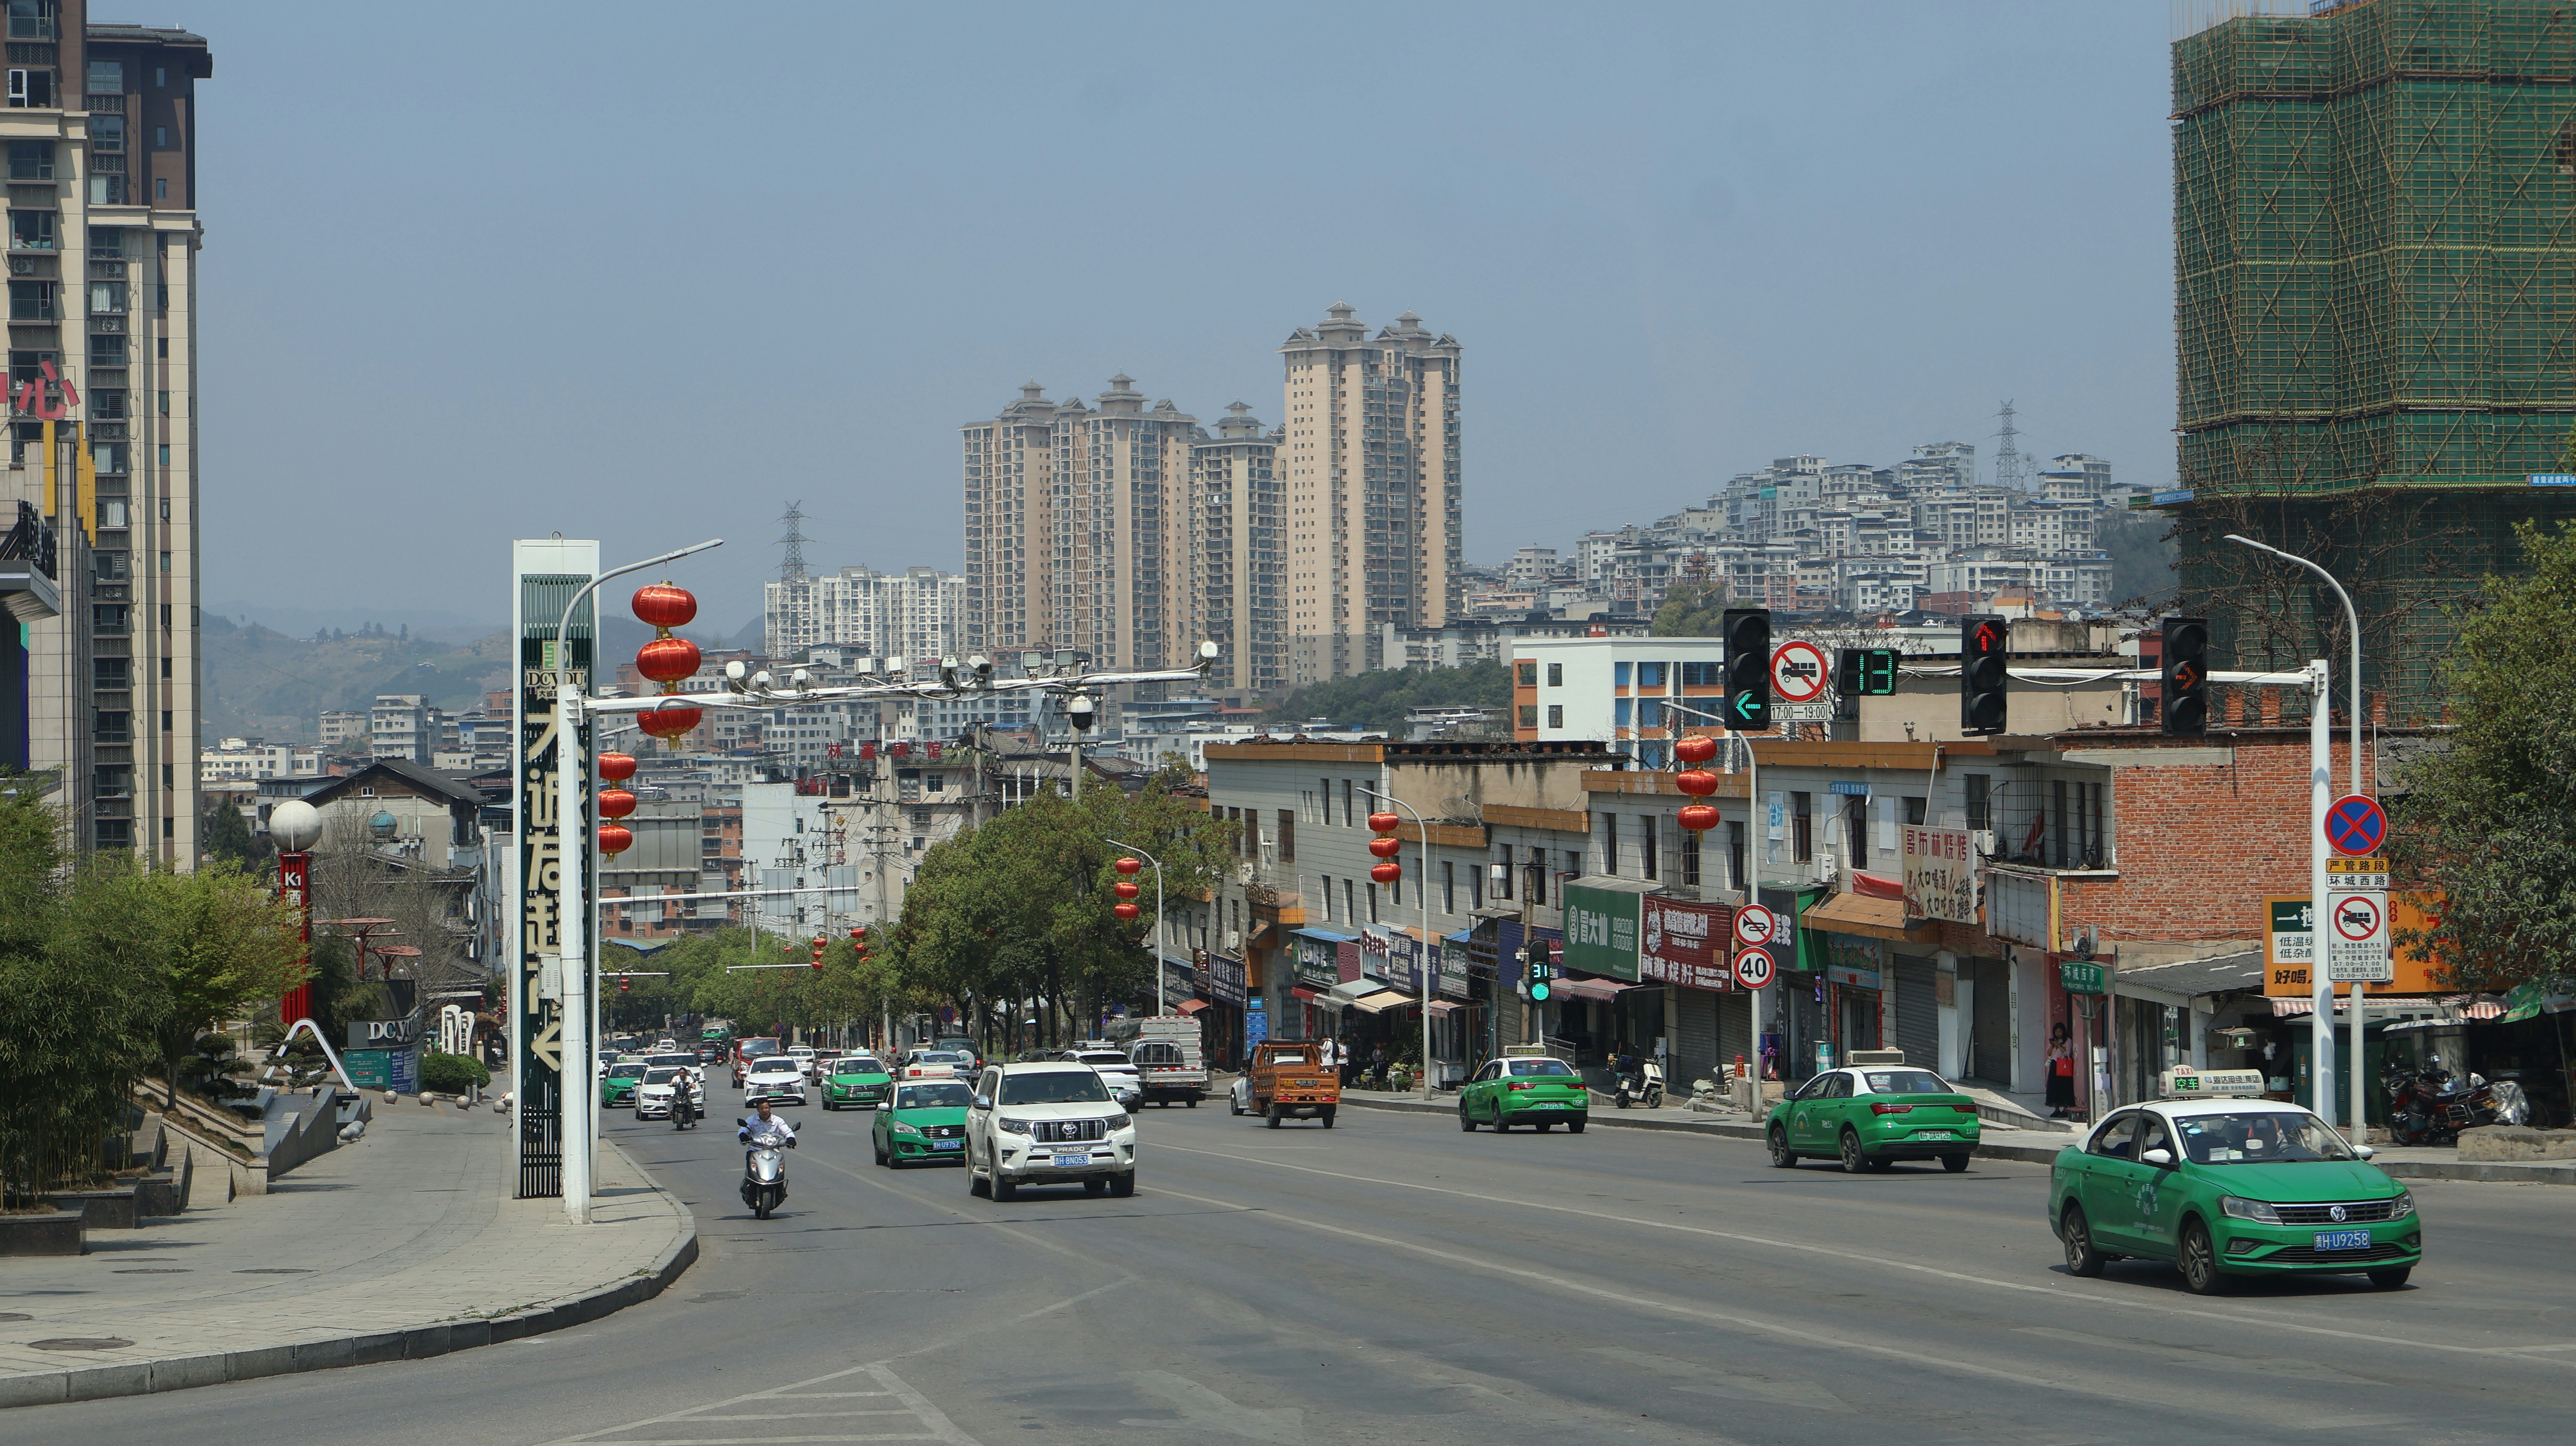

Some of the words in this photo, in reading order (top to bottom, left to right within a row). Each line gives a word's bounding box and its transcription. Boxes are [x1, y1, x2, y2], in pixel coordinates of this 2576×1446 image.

[0, 360, 81, 420] 心
[1859, 650, 1892, 694] 13
[828, 741, 942, 759] 林鑫宾馆
[1907, 829, 1967, 861] 哥布林烧烤
[2329, 860, 2385, 871] 严管路段
[285, 872, 301, 886] K1
[1917, 866, 1946, 890] 大口喝酒
[2329, 875, 2385, 886] 环城西路
[1926, 893, 1955, 918] 大口吃肉
[1533, 964, 1547, 978] 31
[1681, 963, 1693, 984] 沙子
[1741, 957, 1767, 978] 40
[2064, 966, 2094, 983] 环城西路
[2177, 1078, 2199, 1090] 空车
